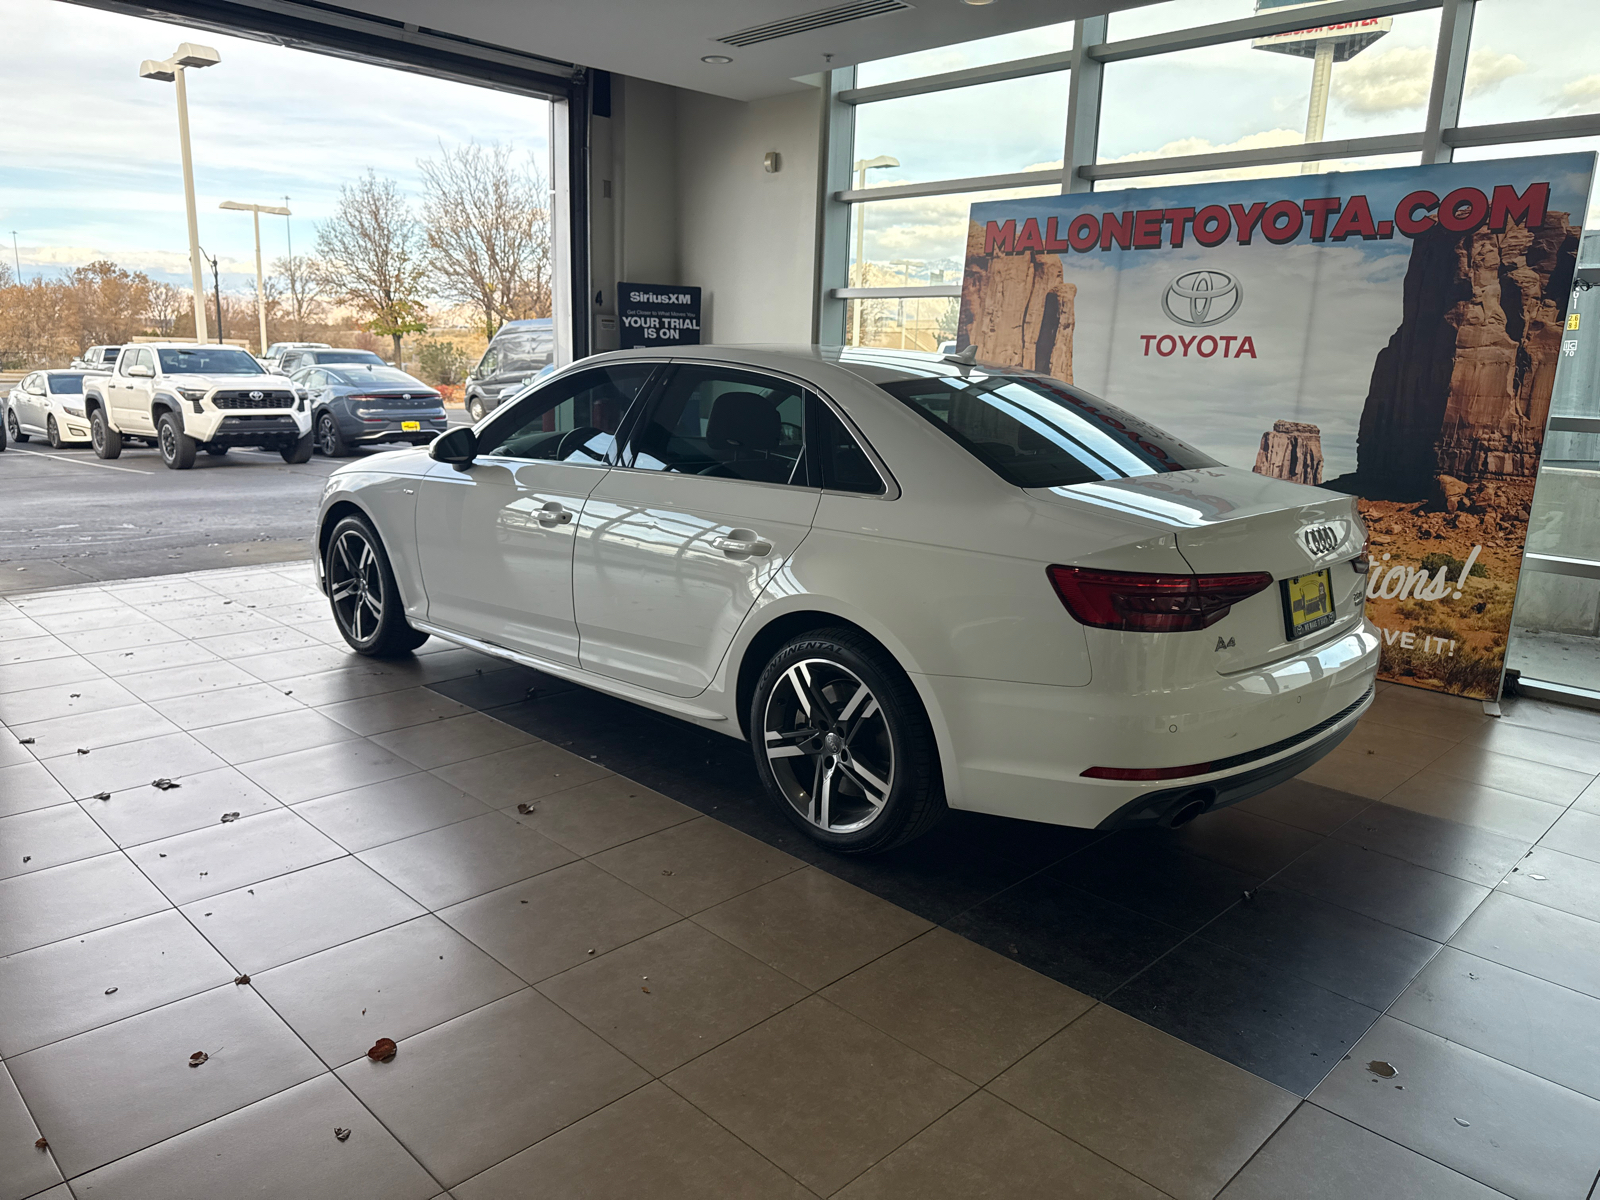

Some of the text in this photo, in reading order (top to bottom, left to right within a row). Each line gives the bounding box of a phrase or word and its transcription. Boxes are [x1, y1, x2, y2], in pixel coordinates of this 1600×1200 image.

[984, 182, 1550, 255] MALONETOYOTA.COM
[630, 292, 691, 304] SiriusXM
[622, 316, 660, 328] YOUR
[662, 318, 700, 330] TRIAL
[644, 328, 680, 340] IS ON
[1140, 334, 1257, 359] TOYOTA
[1214, 635, 1236, 653] A4
[1376, 627, 1456, 657] VE IT!
[760, 642, 843, 691] CONTINENTAL
